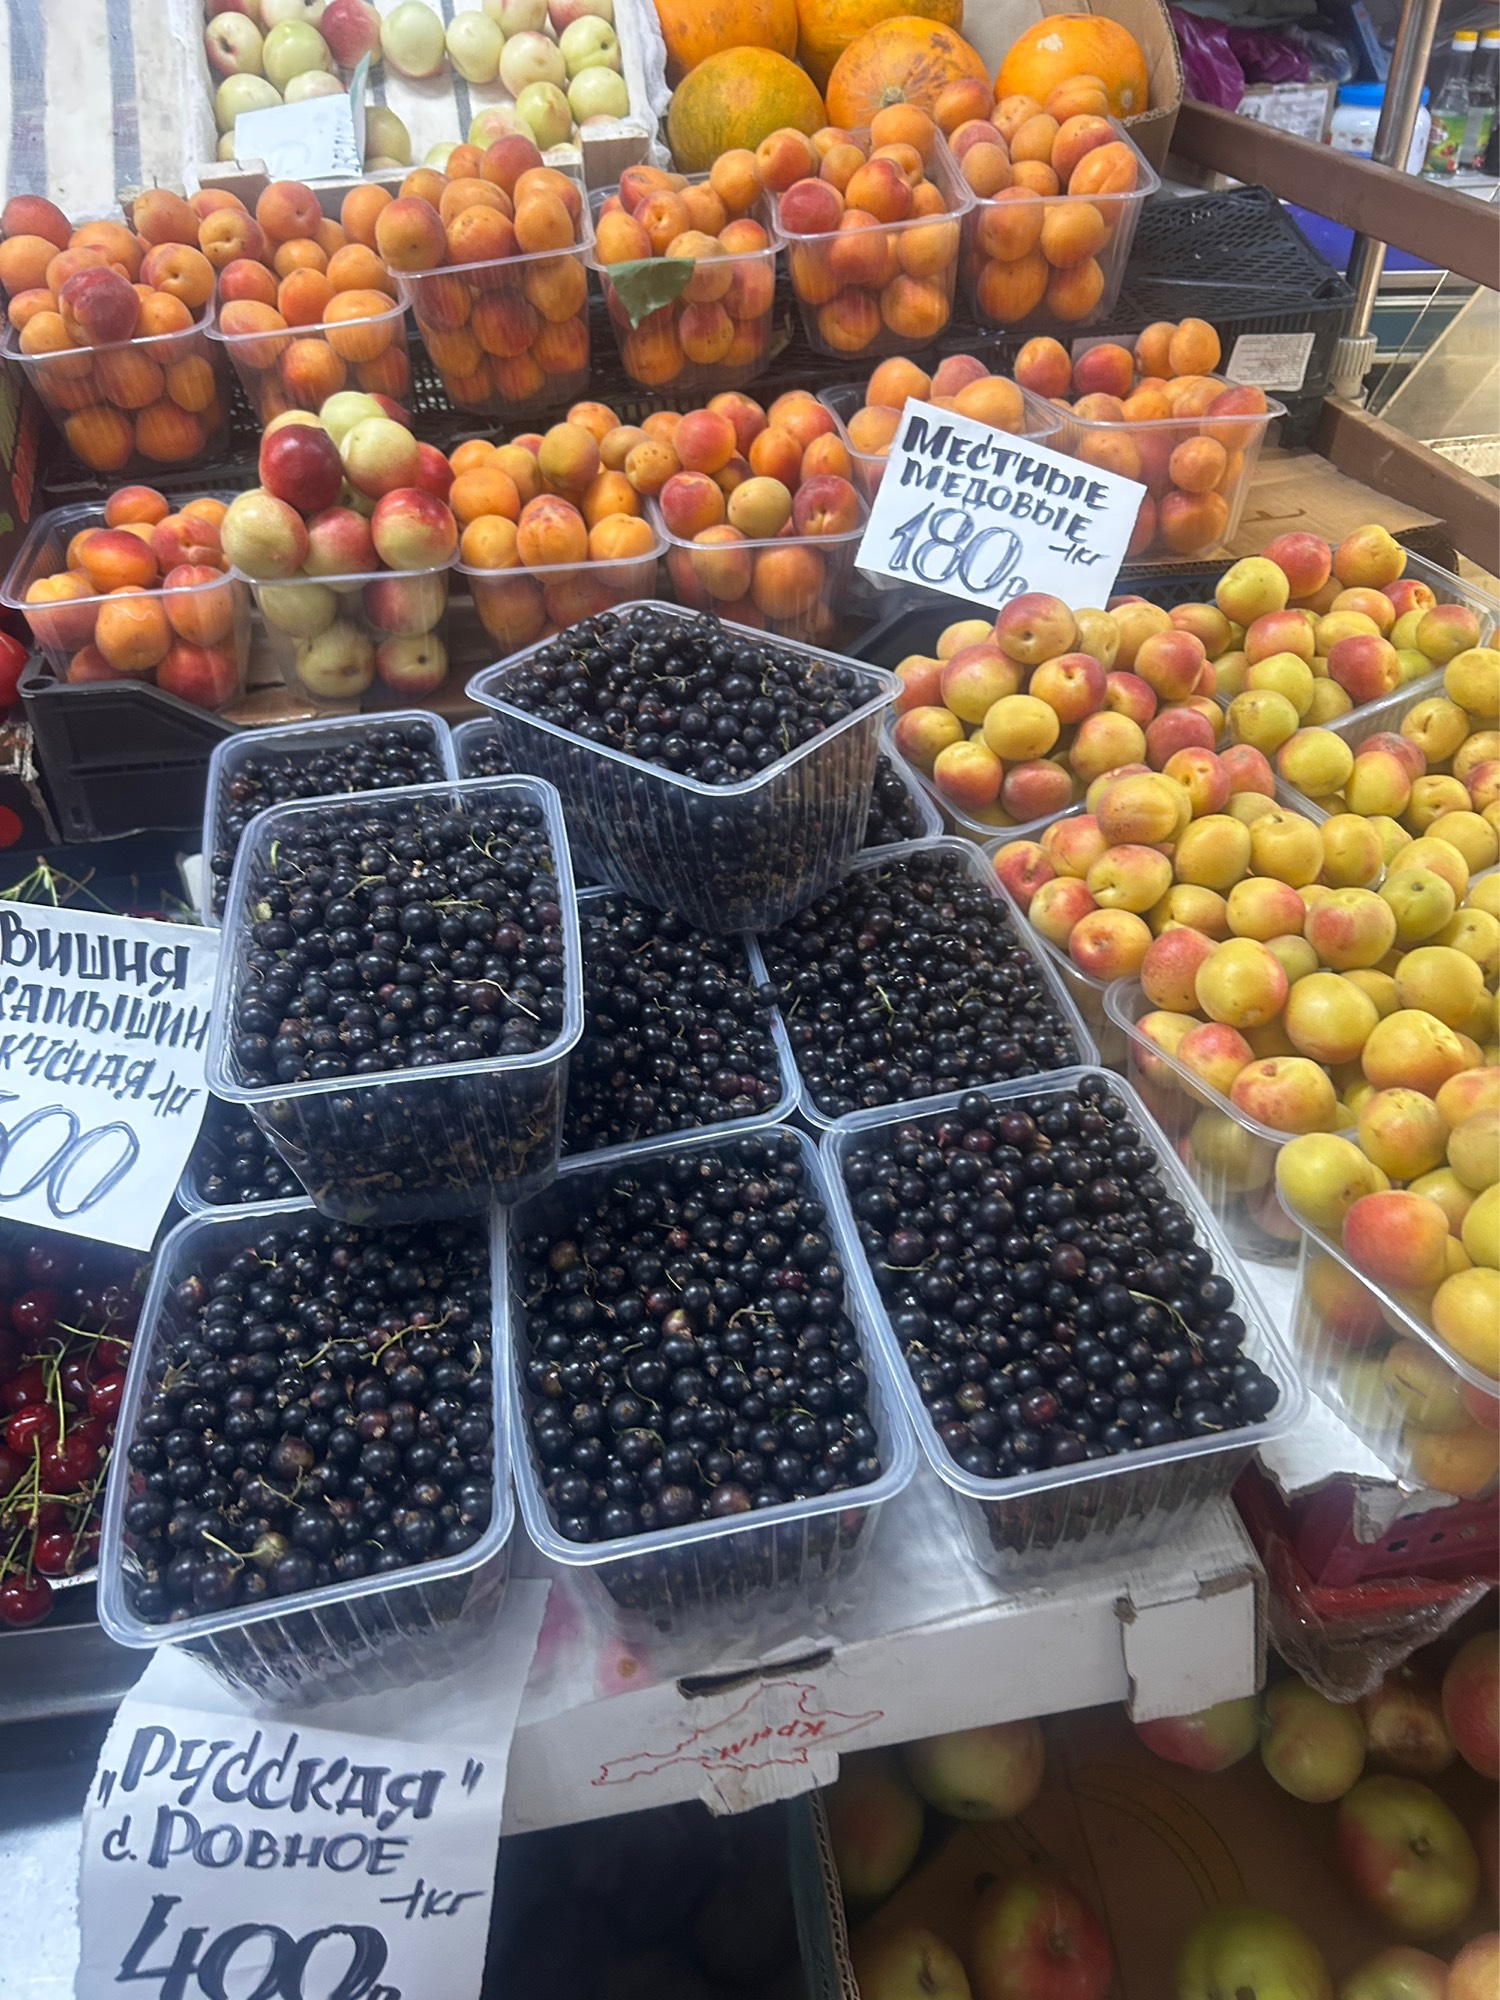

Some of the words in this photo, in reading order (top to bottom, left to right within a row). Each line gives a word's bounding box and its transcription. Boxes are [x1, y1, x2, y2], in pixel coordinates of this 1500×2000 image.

[900, 457, 1094, 543] МЕДОВЫЕ
[0, 910, 190, 997] ВИШНЯ
[147, 1804, 413, 1875] РОВНОЕ
